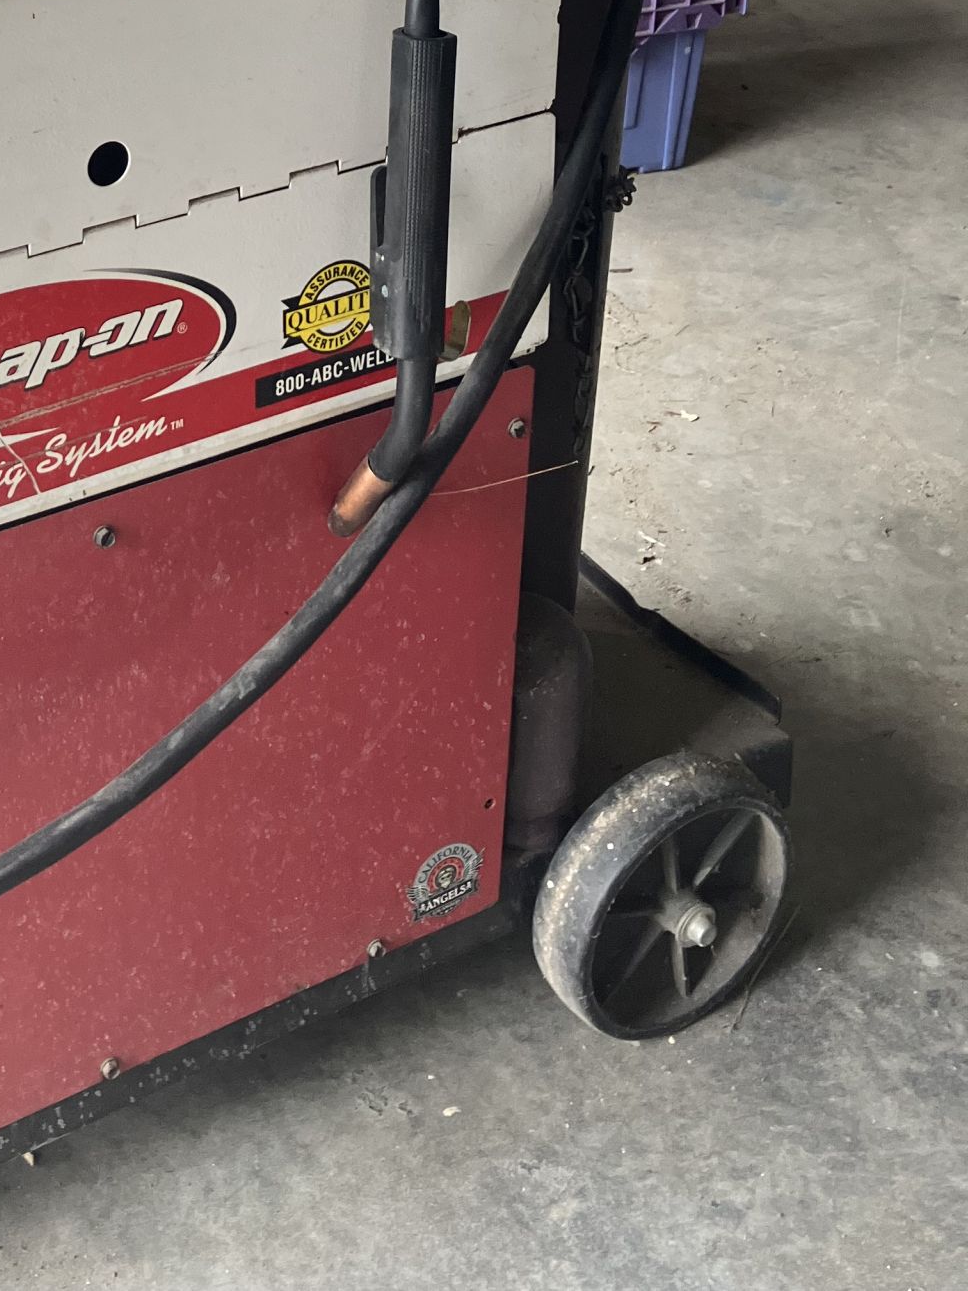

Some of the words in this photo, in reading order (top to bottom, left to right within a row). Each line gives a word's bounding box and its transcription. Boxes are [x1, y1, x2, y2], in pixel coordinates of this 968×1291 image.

[304, 265, 369, 300] ASSURANCE
[287, 290, 369, 332] QUALIT
[307, 320, 364, 350] CERTIFIED
[36, 415, 168, 477] System
[417, 845, 473, 884] CALIFORNIA
[425, 884, 468, 911] ANGELS
